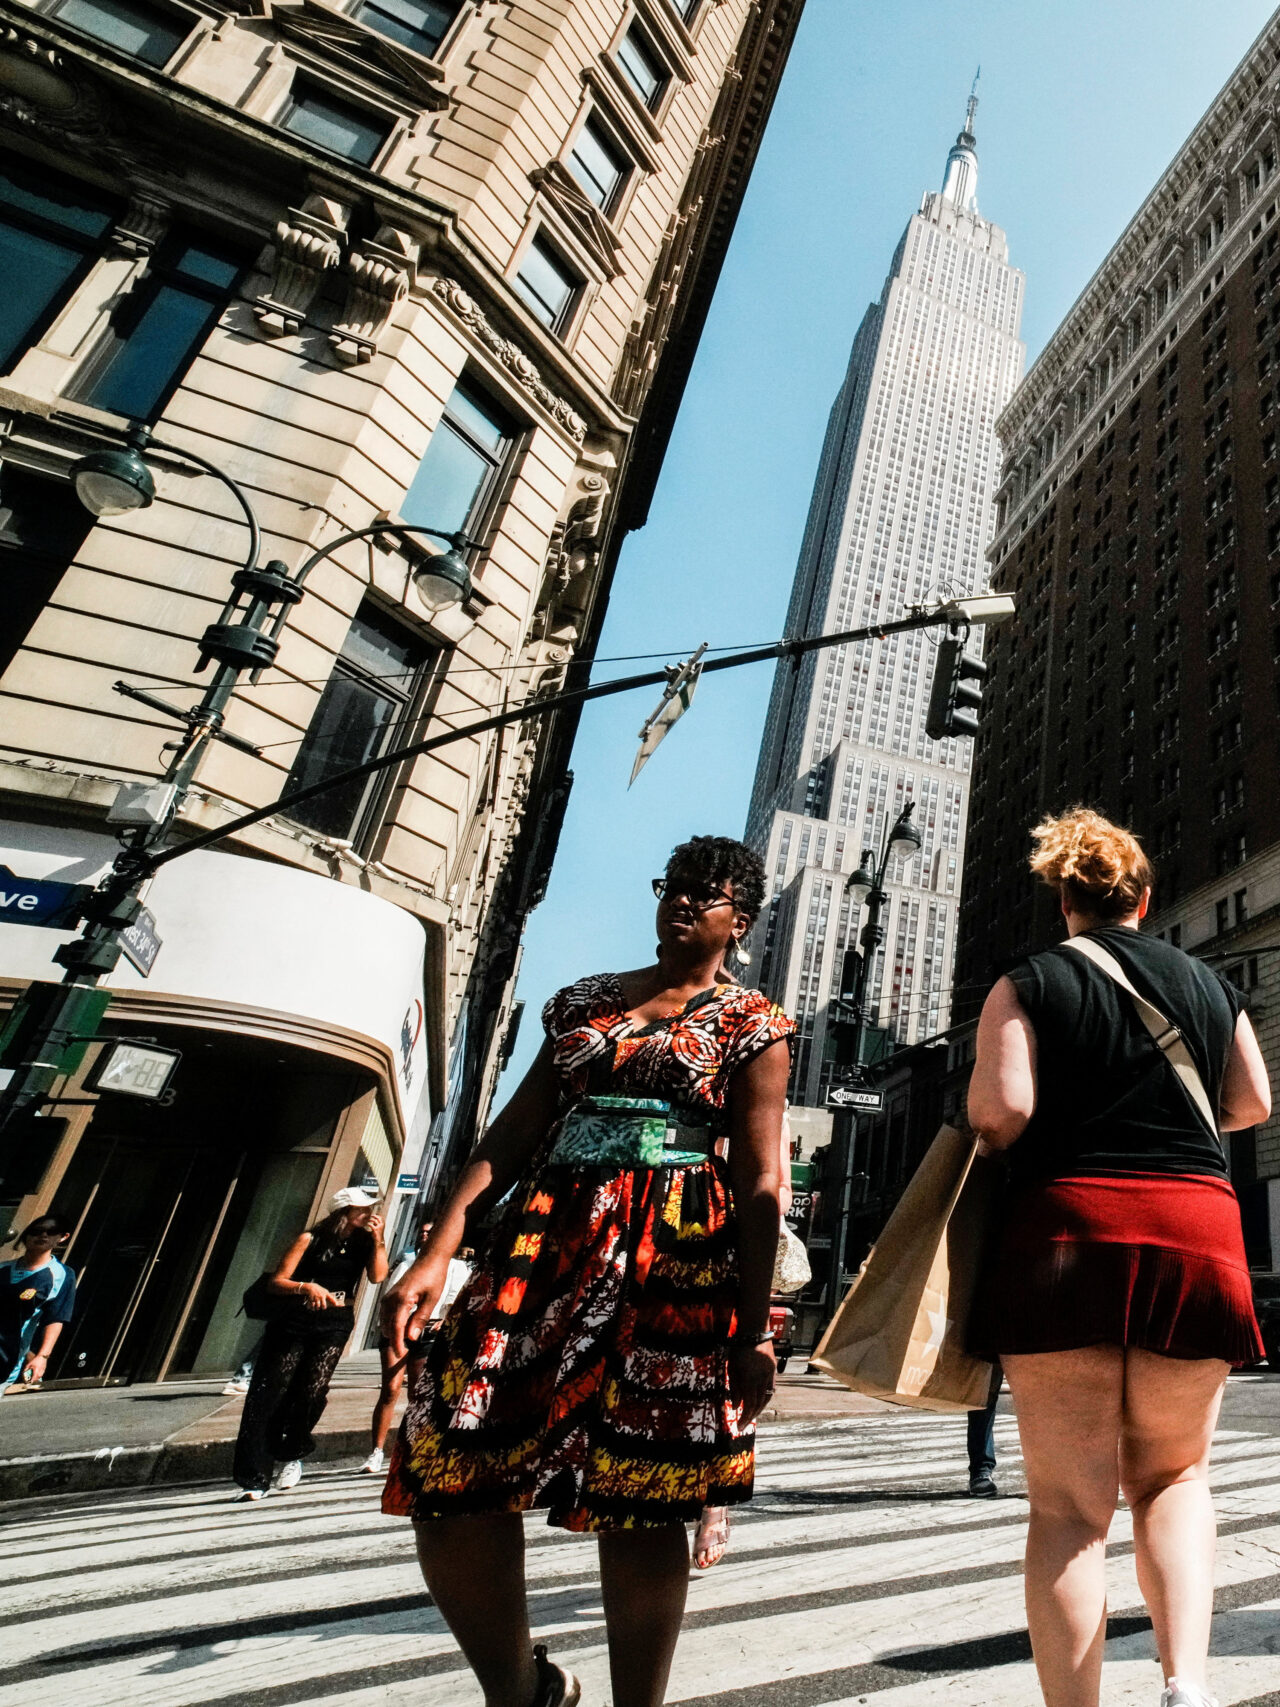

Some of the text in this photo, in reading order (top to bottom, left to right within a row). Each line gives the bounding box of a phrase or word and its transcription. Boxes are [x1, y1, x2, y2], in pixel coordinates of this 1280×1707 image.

[0, 891, 38, 910] ve
[836, 1091, 850, 1099] ONE
[784, 1206, 806, 1218] RK
